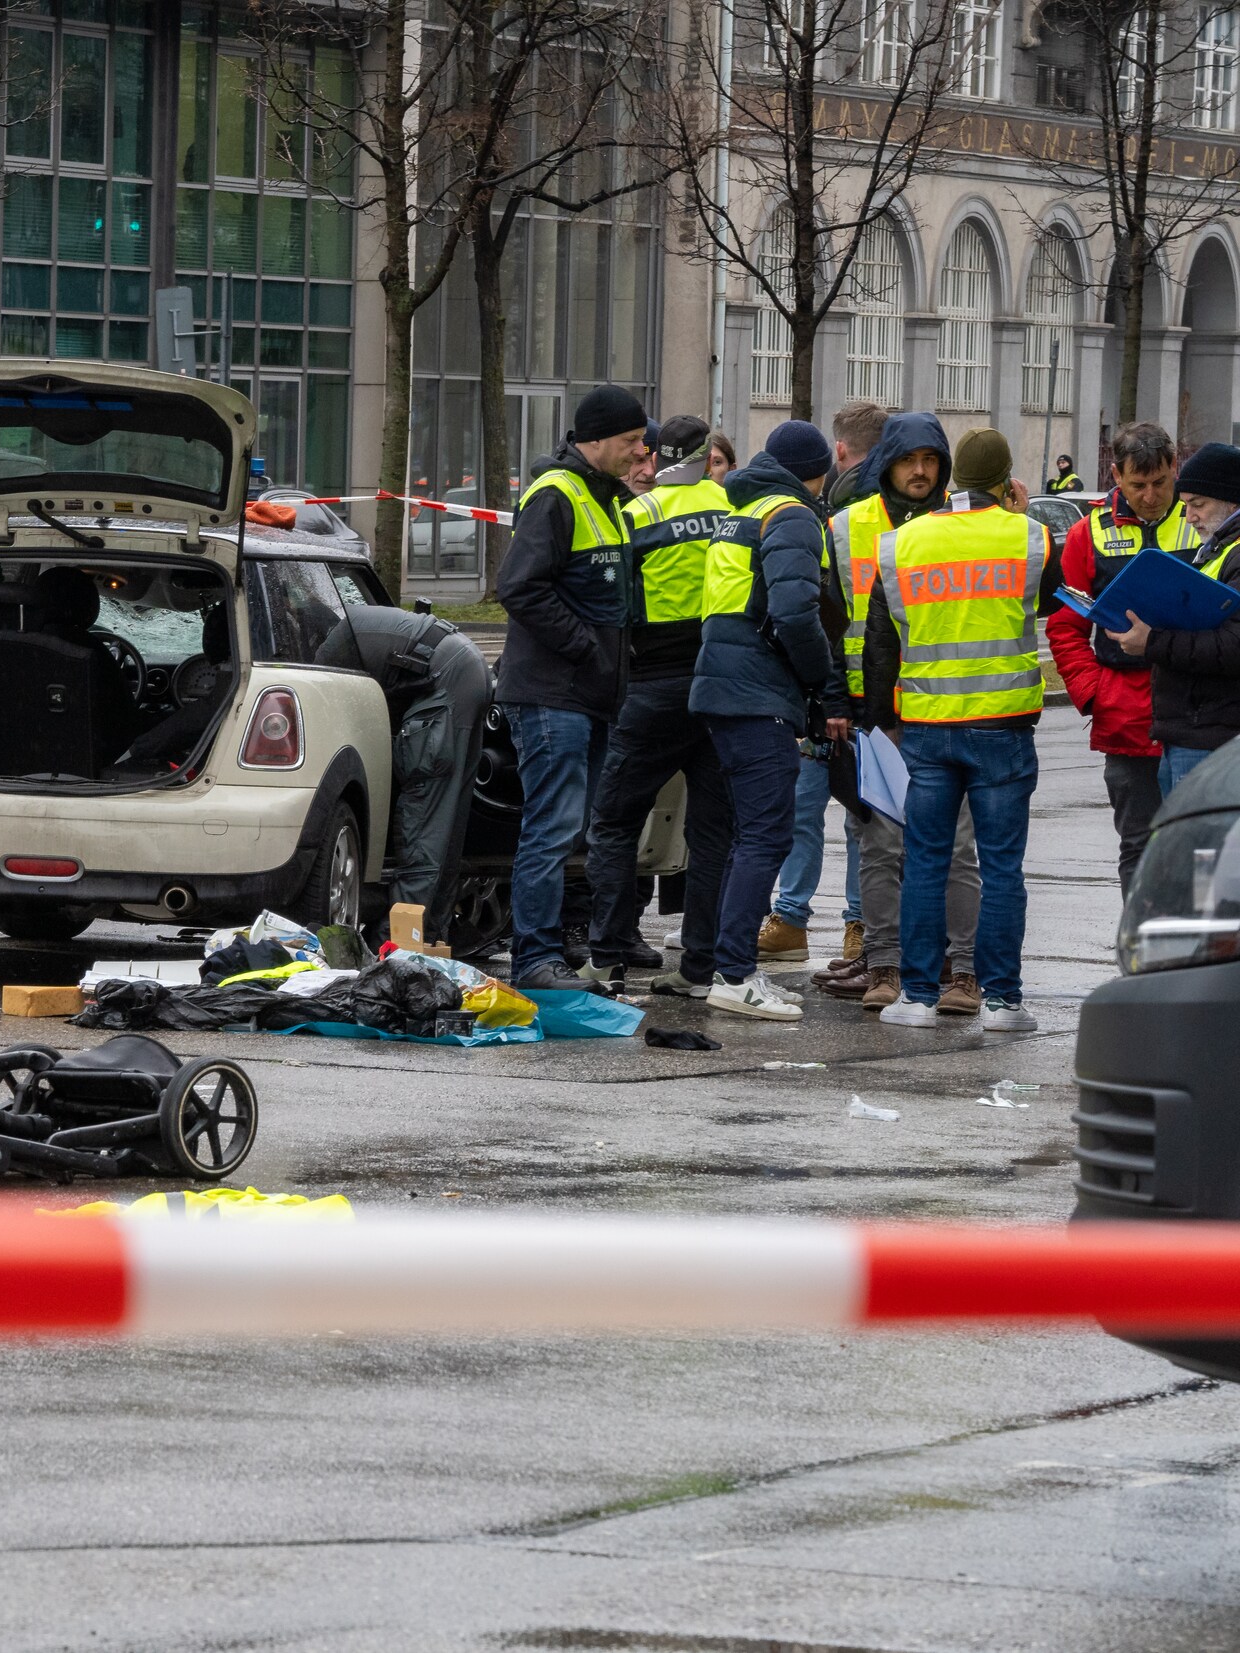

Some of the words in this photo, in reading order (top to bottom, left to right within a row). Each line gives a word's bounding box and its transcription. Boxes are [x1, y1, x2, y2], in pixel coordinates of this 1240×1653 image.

[671, 515, 727, 539] POLI
[1106, 540, 1133, 549] POLIZEI
[860, 564, 873, 587] P
[911, 564, 1017, 598] POLIZEI
